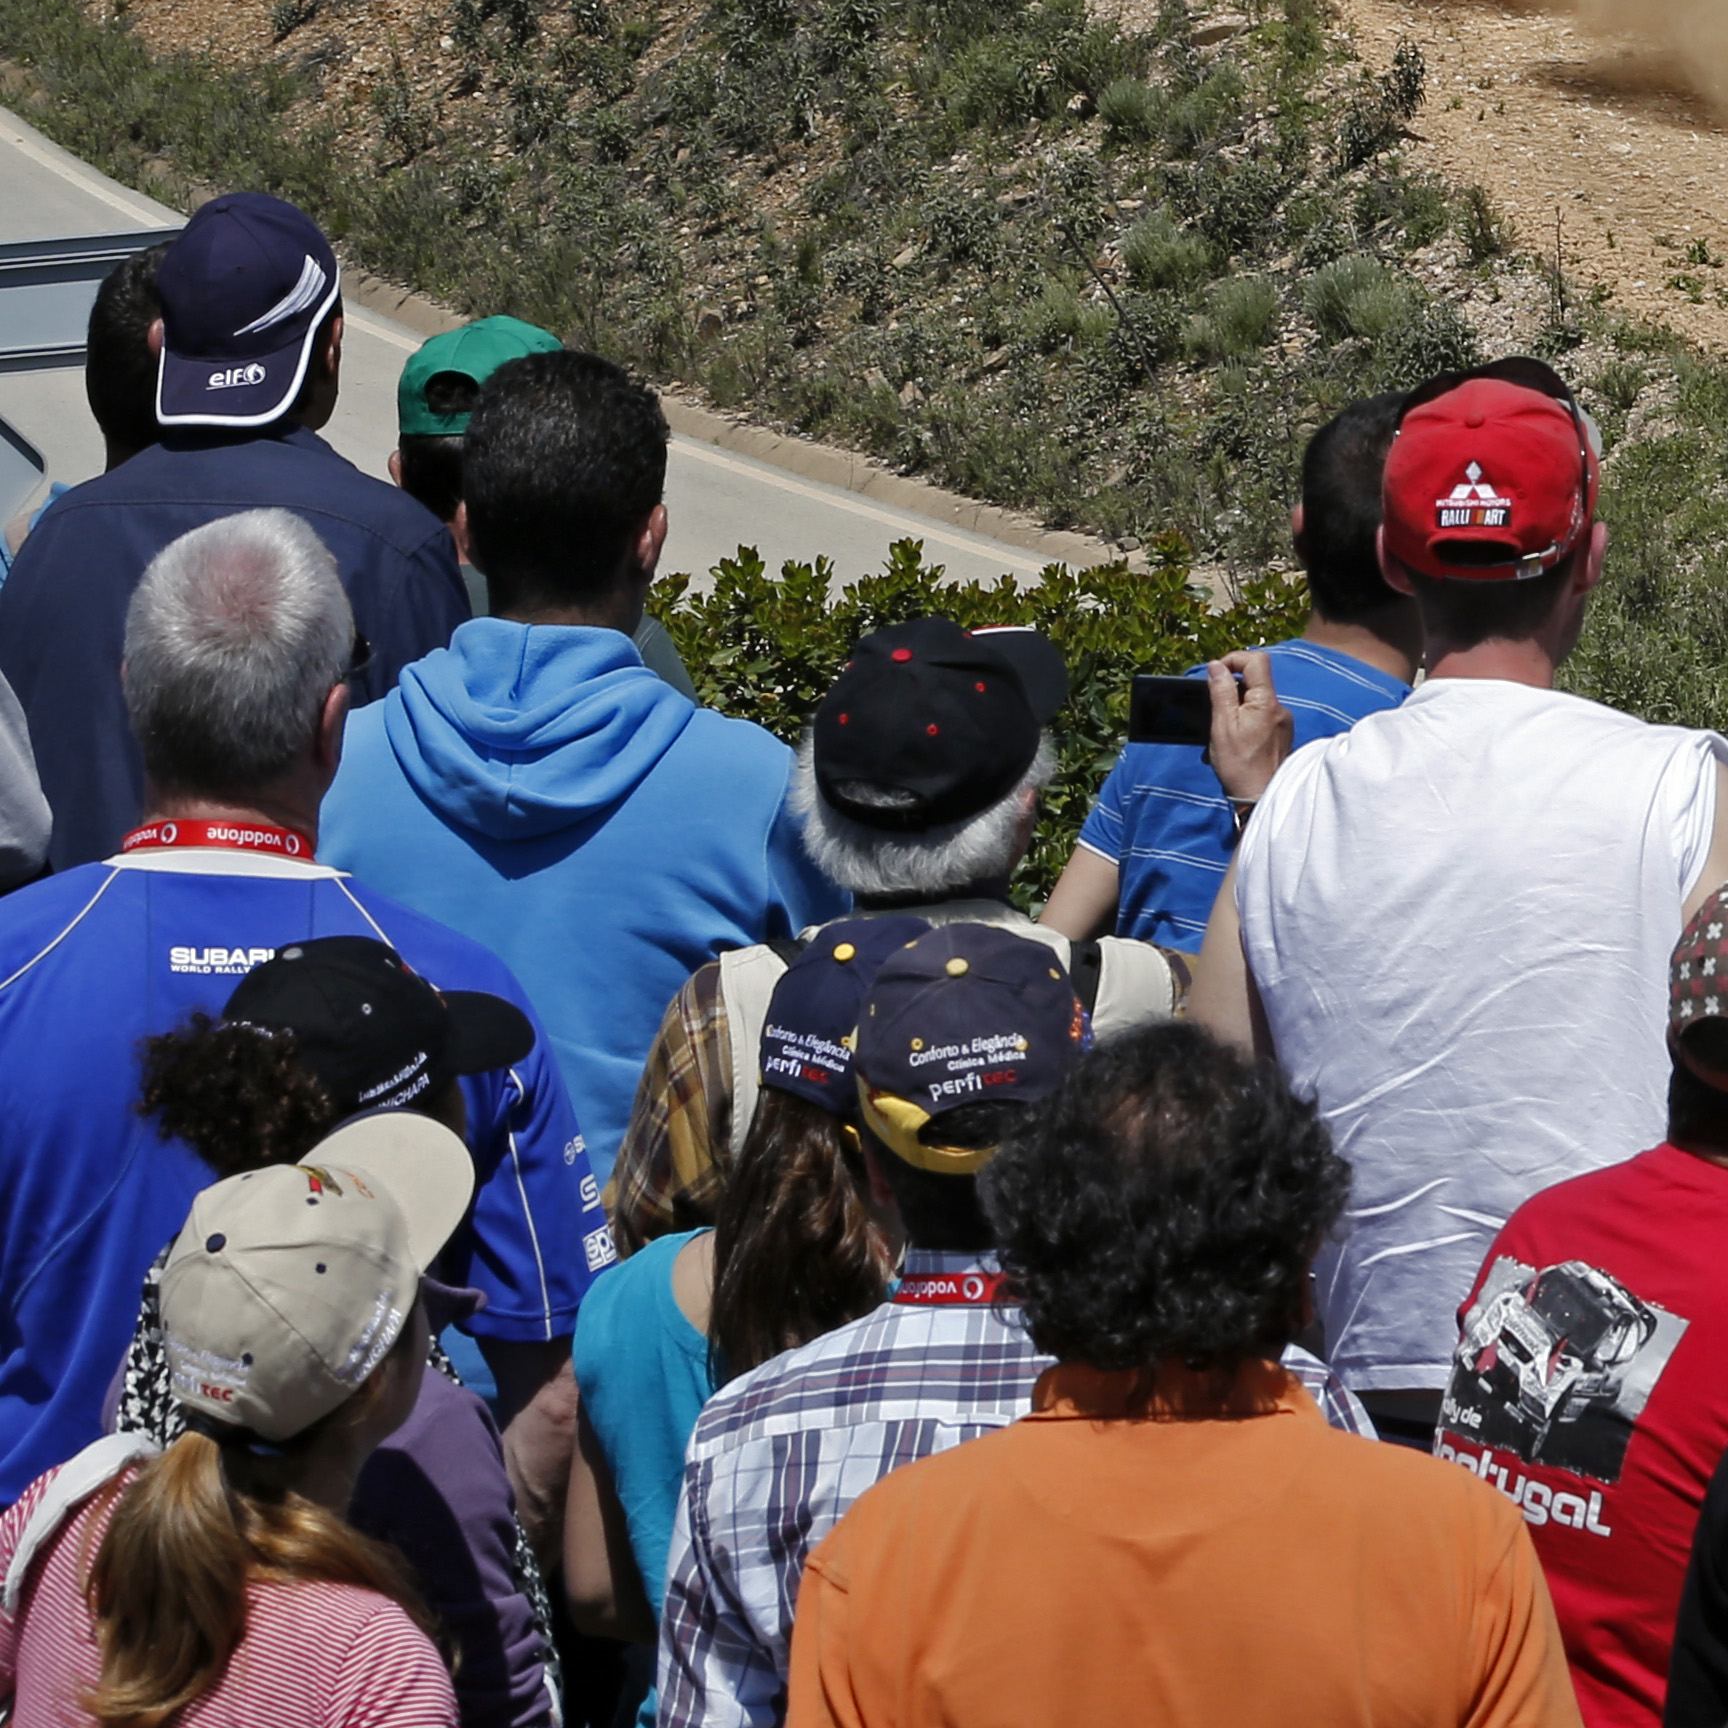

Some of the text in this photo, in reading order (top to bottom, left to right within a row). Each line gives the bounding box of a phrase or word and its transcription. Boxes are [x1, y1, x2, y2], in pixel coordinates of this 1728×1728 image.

[1480, 498, 1512, 507] MOTORS
[1441, 509, 1506, 527] RALLI ART
[207, 826, 282, 846] vodafone
[170, 964, 251, 974] WORLD RALLY
[909, 1044, 960, 1067] Conforto
[1460, 1405, 1483, 1430] de
